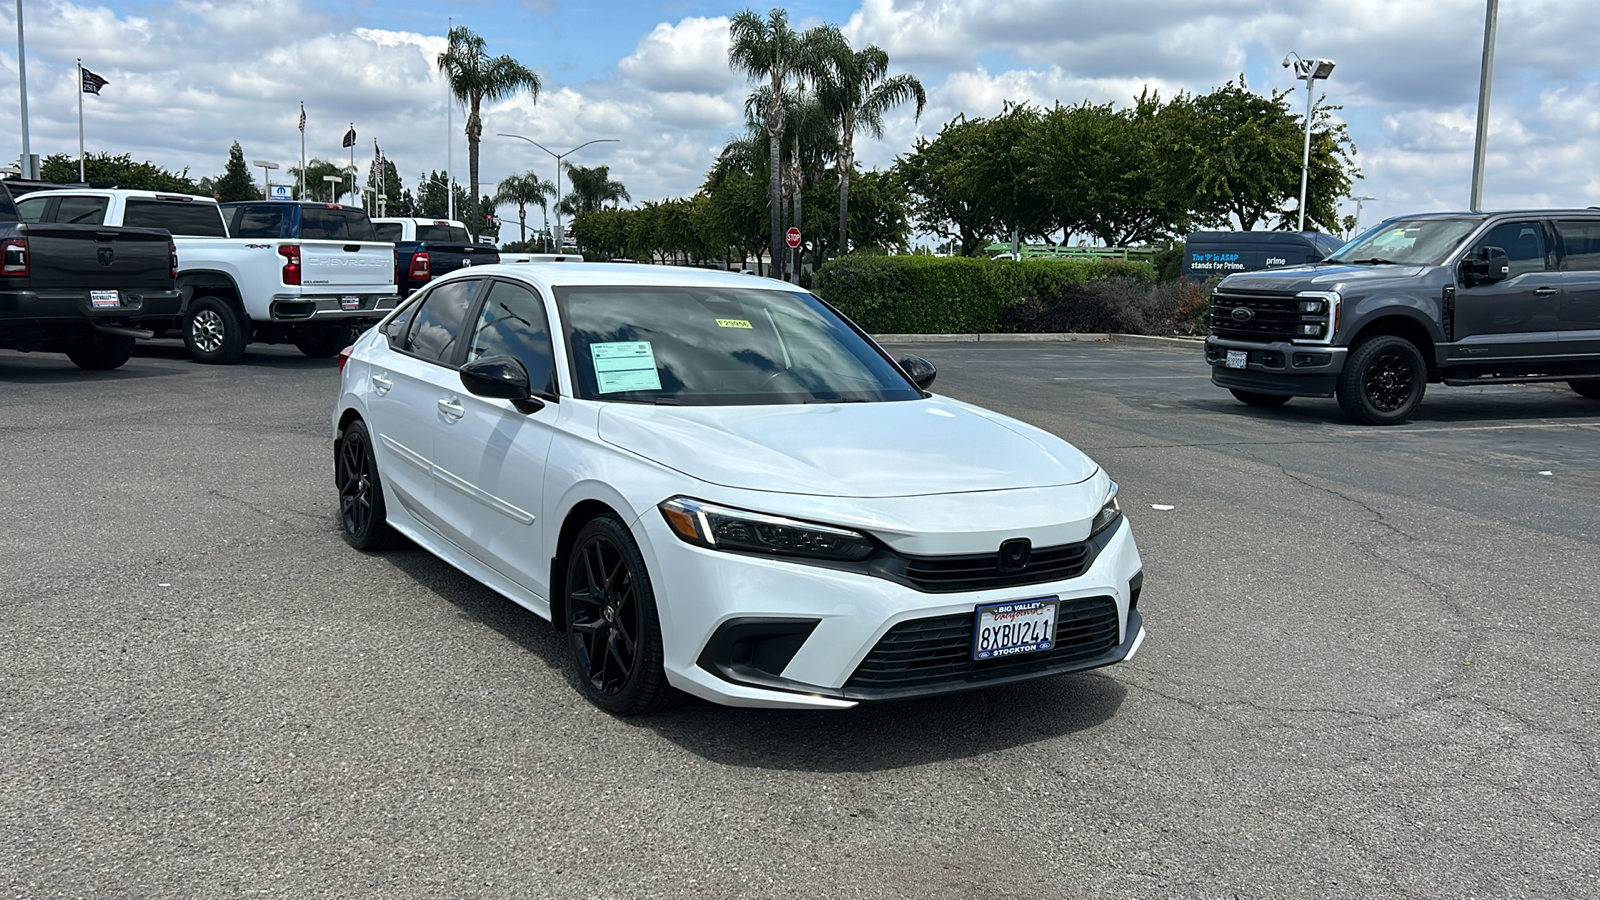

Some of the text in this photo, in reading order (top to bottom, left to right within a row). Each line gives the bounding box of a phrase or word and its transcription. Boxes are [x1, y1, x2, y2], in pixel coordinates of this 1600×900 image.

[787, 233, 800, 241] STOP
[308, 257, 391, 267] CHEVROLET
[1192, 253, 1204, 261] The
[1213, 253, 1220, 261] in
[1220, 253, 1239, 261] ASAP
[1265, 256, 1286, 266] prime
[1224, 262, 1246, 270] Prime.
[998, 602, 1042, 613] BIG VALLEY
[993, 608, 1044, 623] California
[980, 619, 1050, 651] 8XBU241
[993, 644, 1037, 657] STOCKTON
